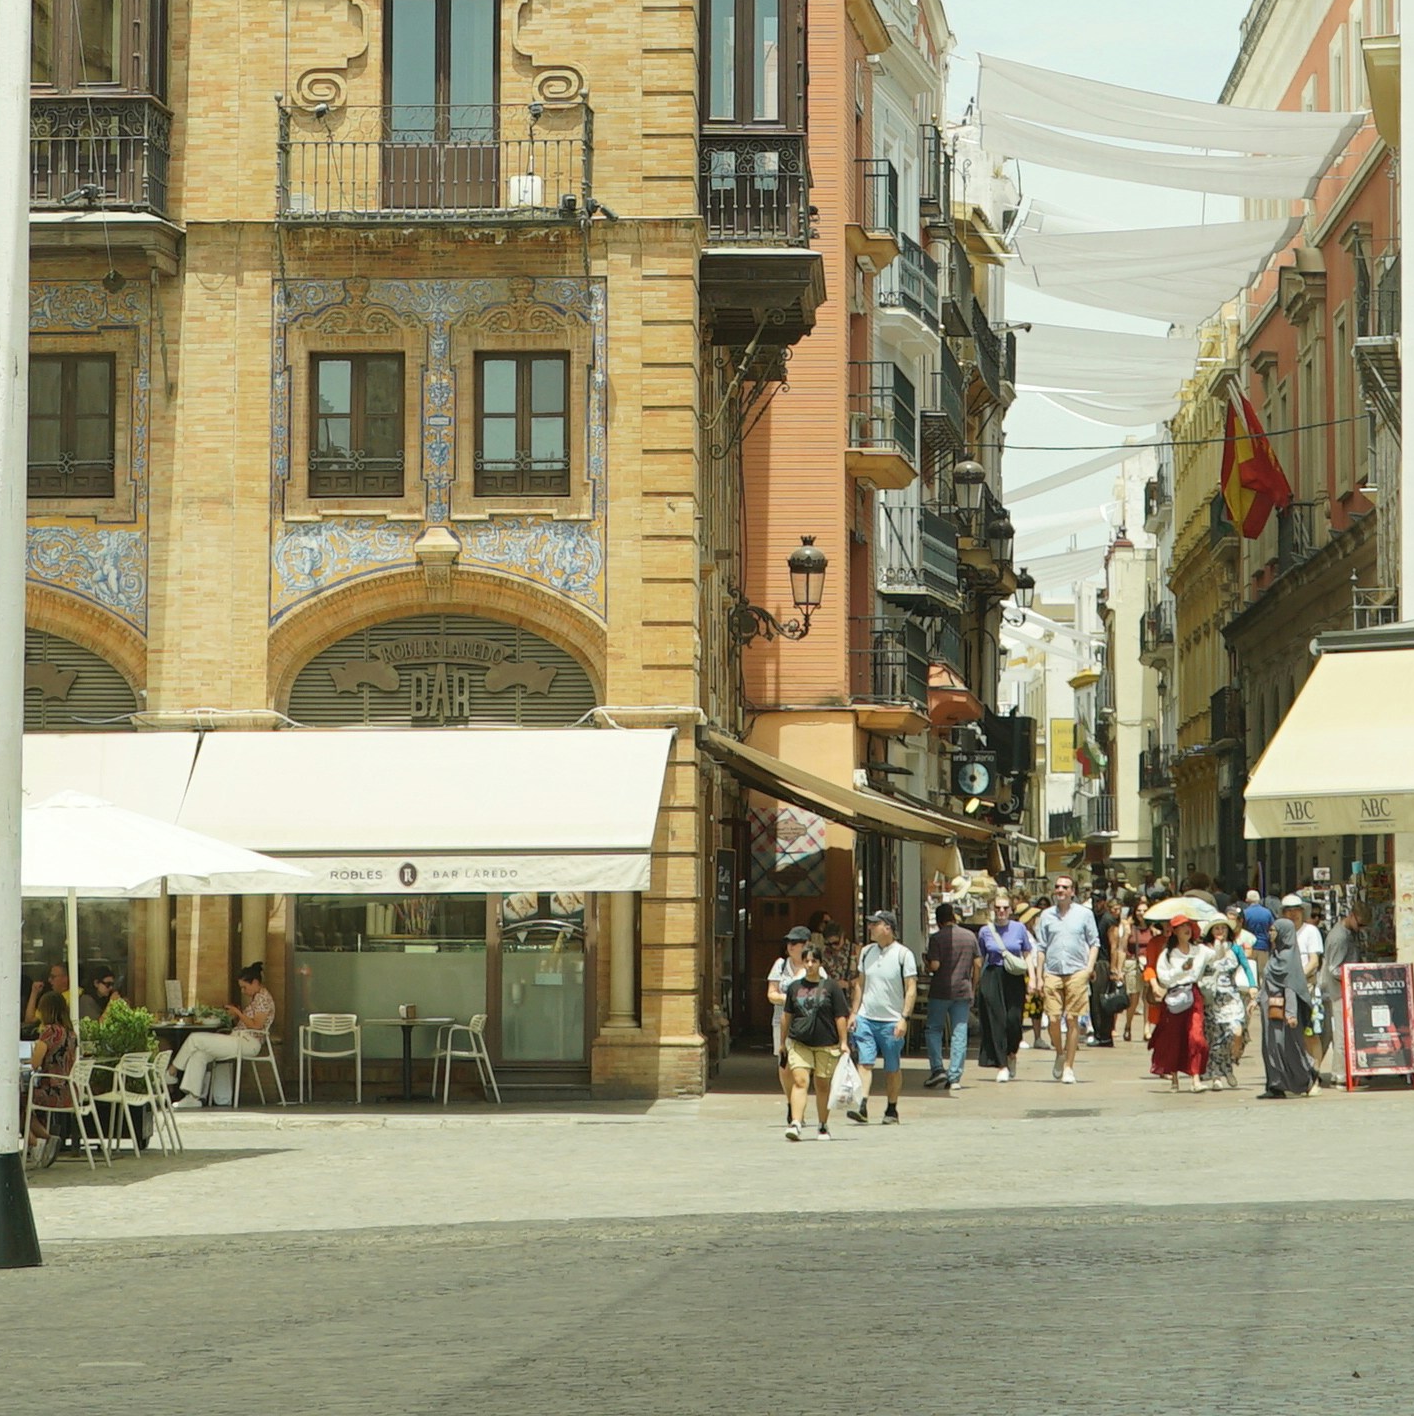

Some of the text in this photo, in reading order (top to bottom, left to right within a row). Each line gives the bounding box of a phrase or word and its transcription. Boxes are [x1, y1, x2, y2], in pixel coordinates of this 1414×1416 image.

[380, 639, 505, 664] ROBLES LAREDO
[411, 663, 470, 722] BAR
[1284, 800, 1315, 821] ABC
[1360, 797, 1391, 818] ABC
[330, 870, 383, 880] ROBLES
[433, 870, 459, 879] BAR
[465, 869, 518, 879] LAREDO
